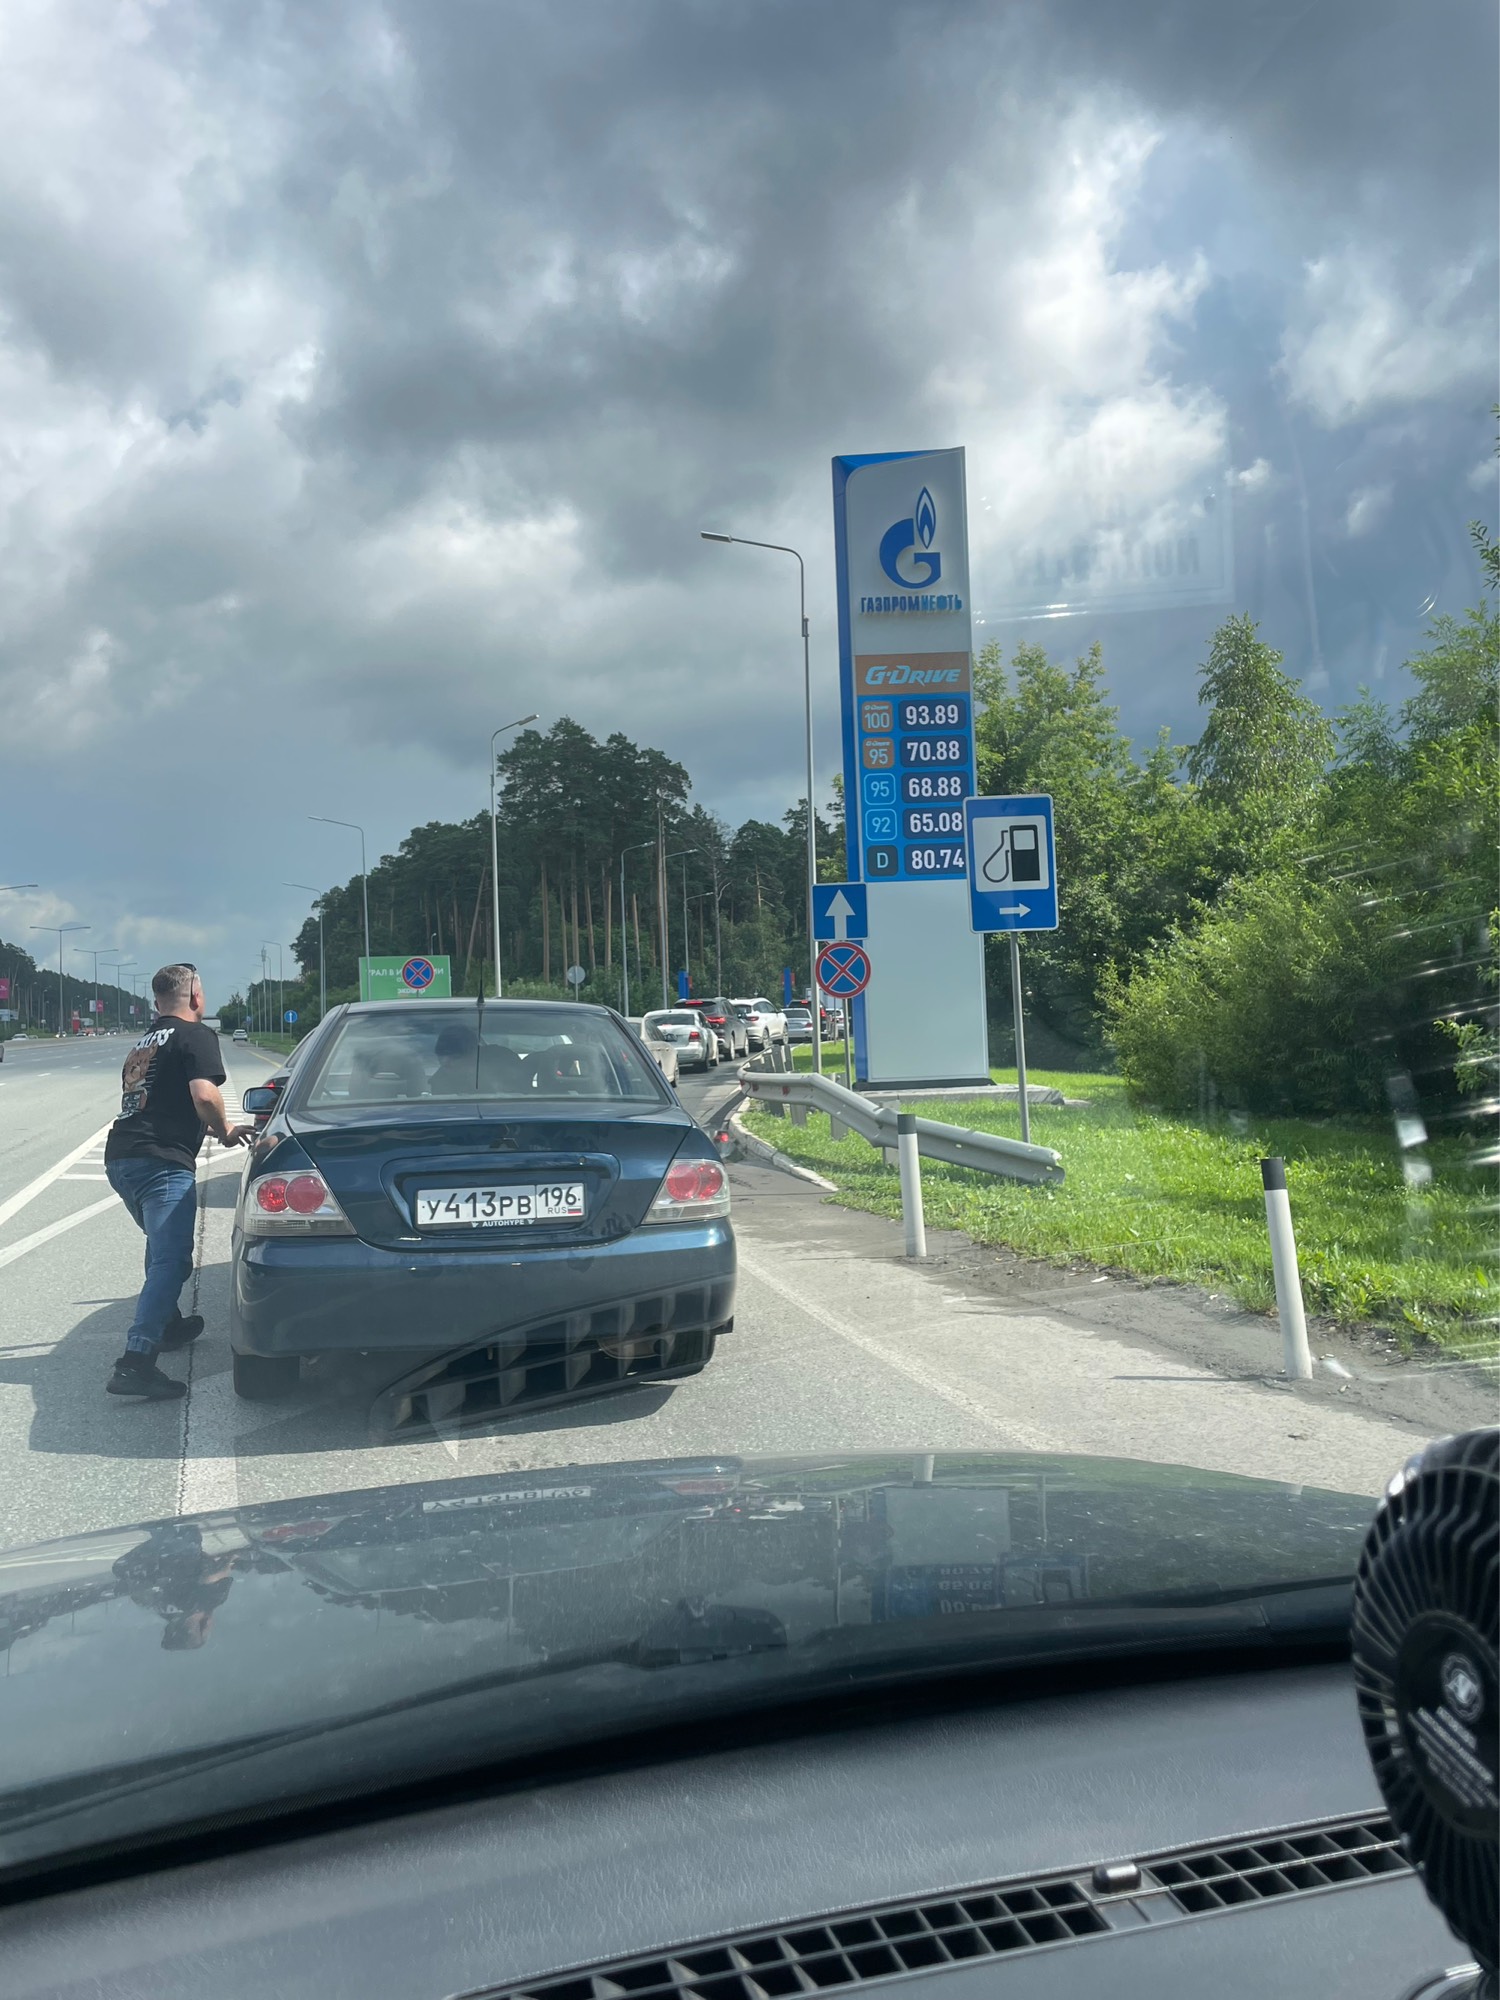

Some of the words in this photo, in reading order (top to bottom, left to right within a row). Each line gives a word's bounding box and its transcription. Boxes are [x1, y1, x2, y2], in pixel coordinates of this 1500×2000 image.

[861, 594, 962, 613] ГАЗПРОМНЕФТЬ
[864, 712, 890, 729] 100
[905, 704, 959, 726] 93.89
[869, 748, 888, 765] 95
[906, 740, 960, 761] 70.88
[870, 780, 890, 798] 95
[908, 776, 962, 798] 68.88
[871, 816, 891, 833] 92
[909, 812, 963, 833] 65.08
[876, 852, 889, 869] D
[911, 848, 965, 870] 80.74
[427, 1191, 532, 1221] У413РВ
[538, 1187, 577, 1207] 196
[482, 1219, 525, 1227] AUTOHYPE
